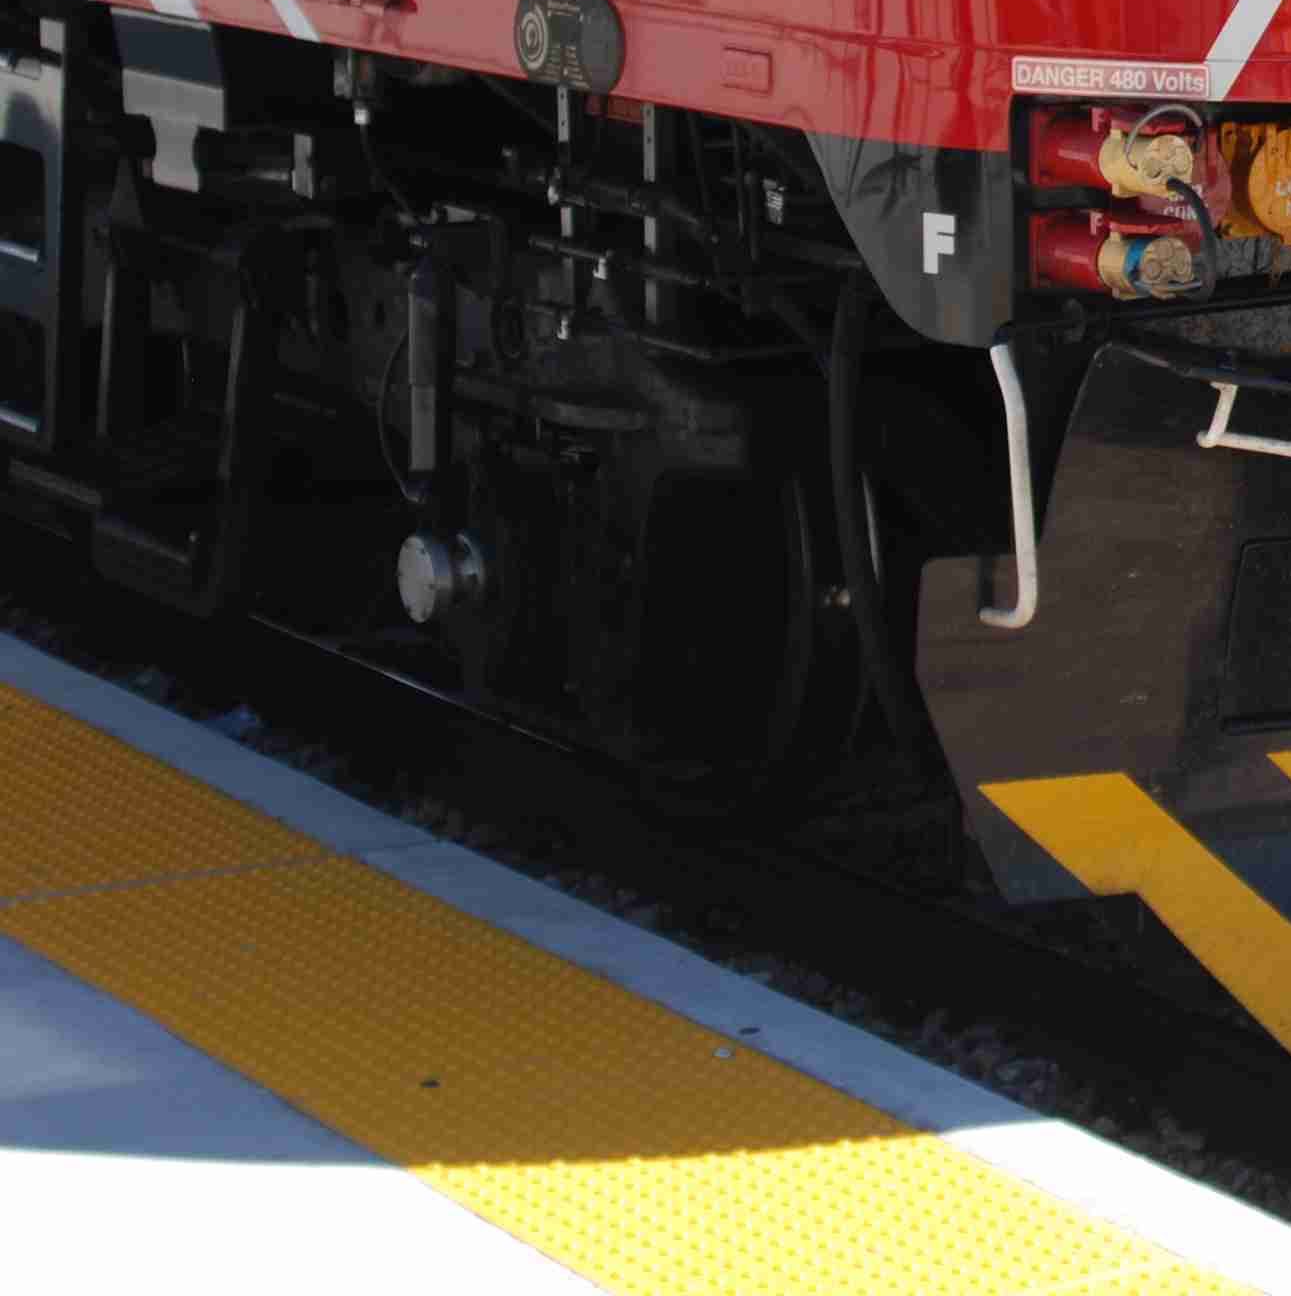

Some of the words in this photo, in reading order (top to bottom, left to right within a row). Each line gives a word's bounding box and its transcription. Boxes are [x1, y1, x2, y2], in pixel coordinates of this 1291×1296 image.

[1016, 63, 1104, 88] DANGER
[1109, 70, 1147, 90] 480
[1152, 70, 1205, 93] Volts
[922, 211, 956, 275] F
